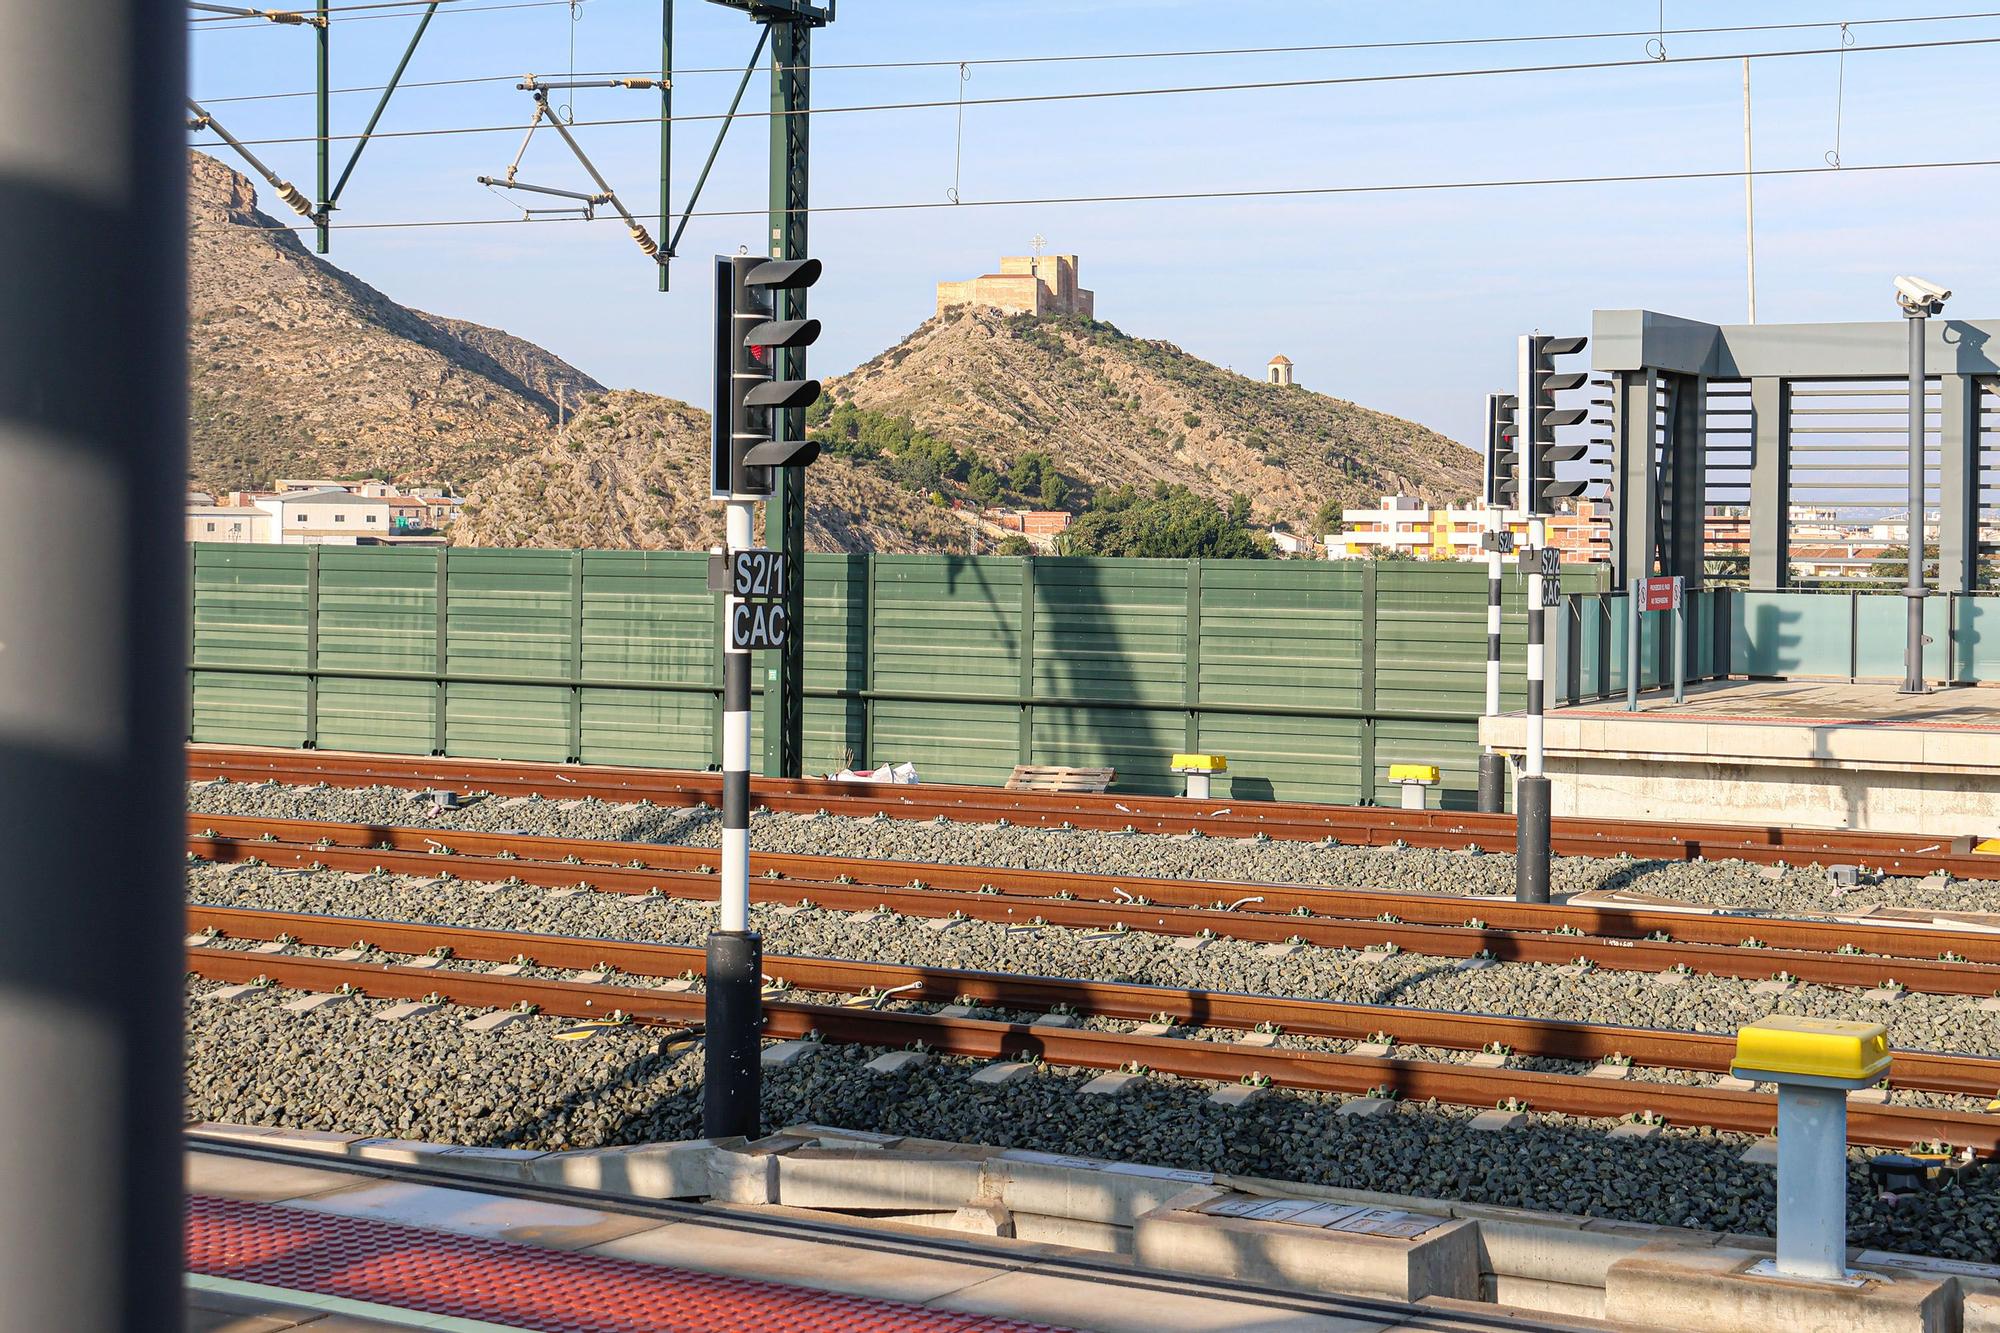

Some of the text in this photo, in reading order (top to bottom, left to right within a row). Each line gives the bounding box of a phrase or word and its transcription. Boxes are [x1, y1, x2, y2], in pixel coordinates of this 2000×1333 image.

[736, 552, 783, 595] S2/1
[1542, 550, 1560, 575] S2/2
[1542, 580, 1560, 605] CAC
[734, 604, 785, 646] CAC
